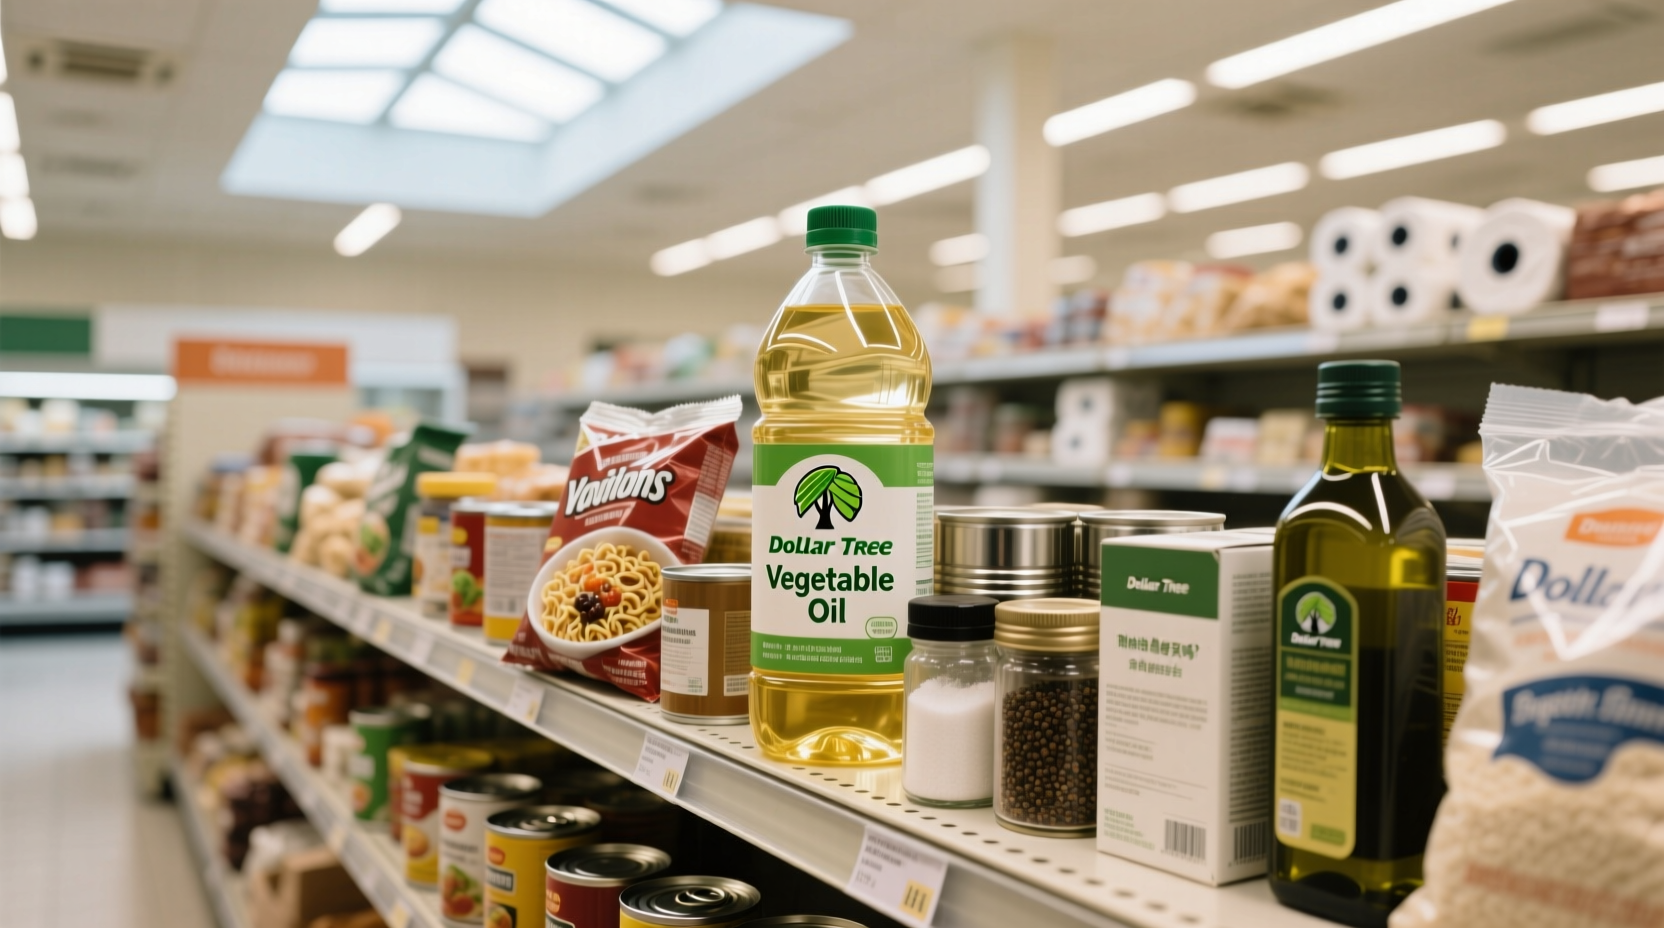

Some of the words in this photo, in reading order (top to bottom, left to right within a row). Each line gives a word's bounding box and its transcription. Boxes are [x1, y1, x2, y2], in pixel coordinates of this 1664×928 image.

[769, 535, 836, 555] Dollar
[765, 564, 895, 598] Vegetable
[808, 597, 847, 624] Oil
